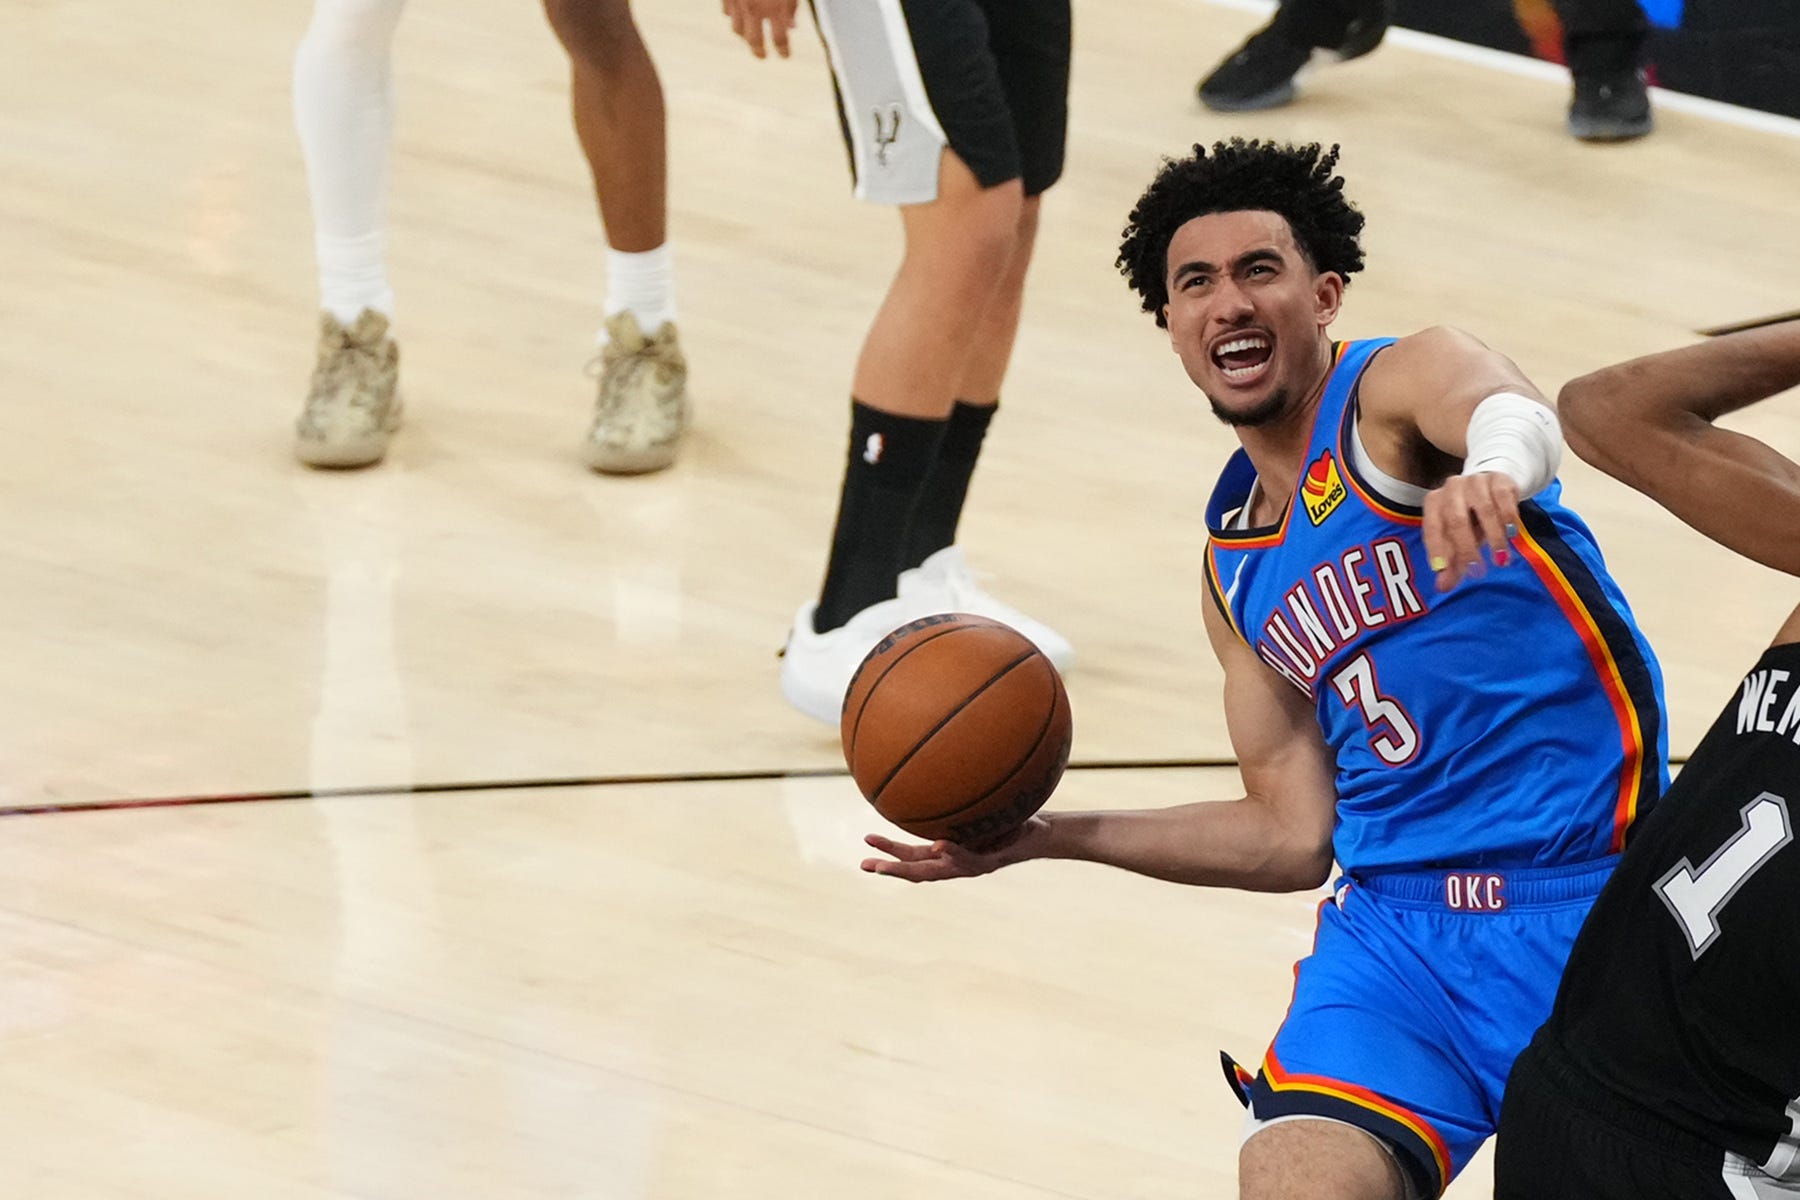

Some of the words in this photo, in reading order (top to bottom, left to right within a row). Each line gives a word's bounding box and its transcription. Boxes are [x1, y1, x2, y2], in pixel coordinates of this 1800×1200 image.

[1258, 537, 1428, 701] HUNDER
[1329, 650, 1421, 765] 3
[1446, 874, 1503, 909] OKC
[1651, 791, 1794, 962] 1
